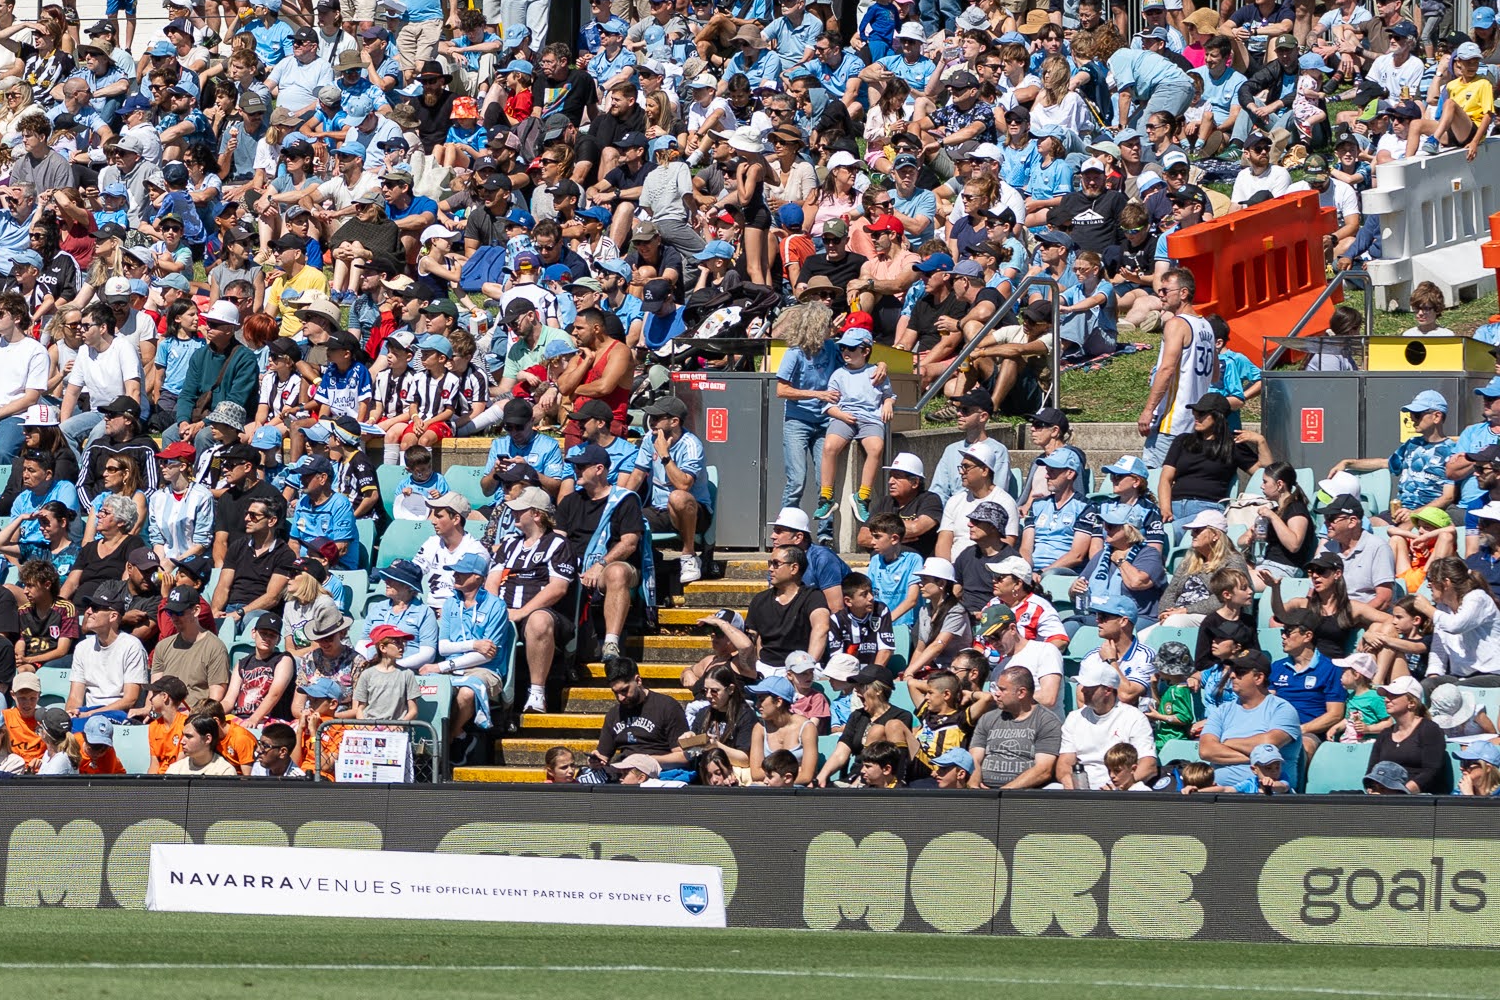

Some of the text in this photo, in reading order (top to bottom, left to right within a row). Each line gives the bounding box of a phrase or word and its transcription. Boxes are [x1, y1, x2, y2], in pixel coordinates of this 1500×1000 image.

[1195, 346, 1214, 378] 30
[613, 719, 626, 735] LOS
[410, 884, 432, 894] THE
[435, 886, 489, 897] OFFICIAL
[493, 888, 529, 898] EVENT
[533, 889, 585, 900] PARTNER
[589, 892, 604, 901] OF
[608, 892, 653, 903] SYDNEY
[657, 894, 672, 904] FC
[802, 830, 1208, 940] MORE
[1299, 856, 1487, 927] goals
